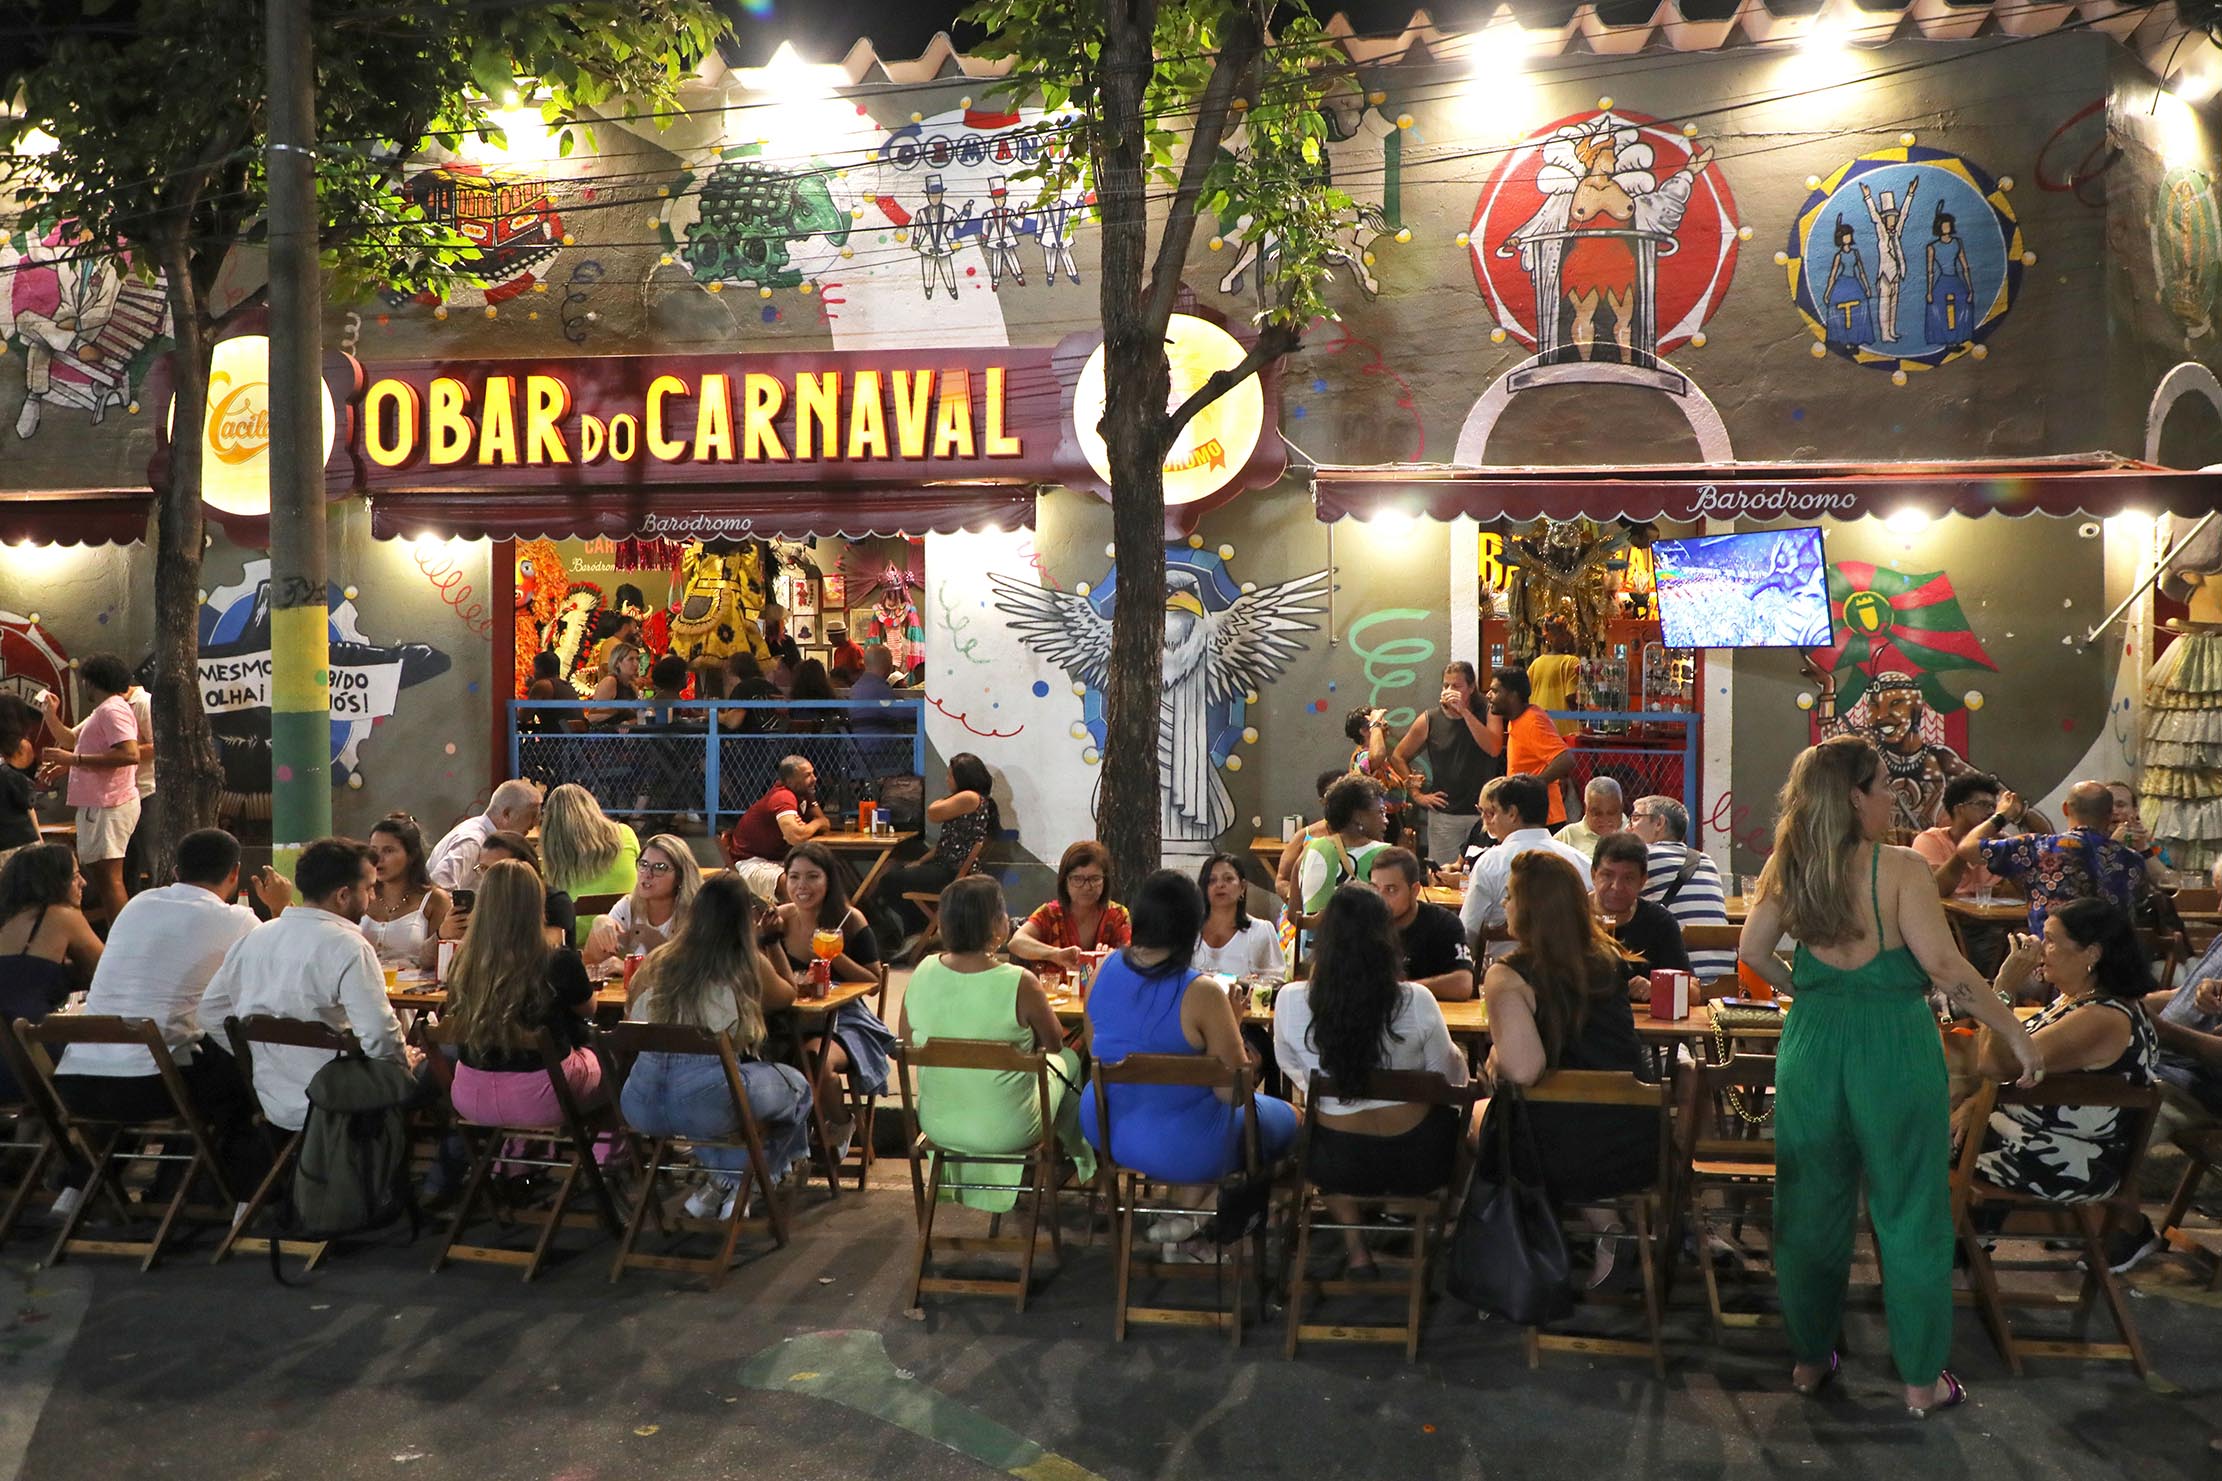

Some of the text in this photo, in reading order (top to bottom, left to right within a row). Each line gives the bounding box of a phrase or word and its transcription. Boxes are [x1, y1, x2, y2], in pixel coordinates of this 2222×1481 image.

[1837, 299, 1860, 329] T
[581, 412, 638, 464] DO
[646, 367, 1022, 463] CARNAVAL
[1686, 485, 1858, 512] Baródromo
[637, 512, 753, 533] Baródromo
